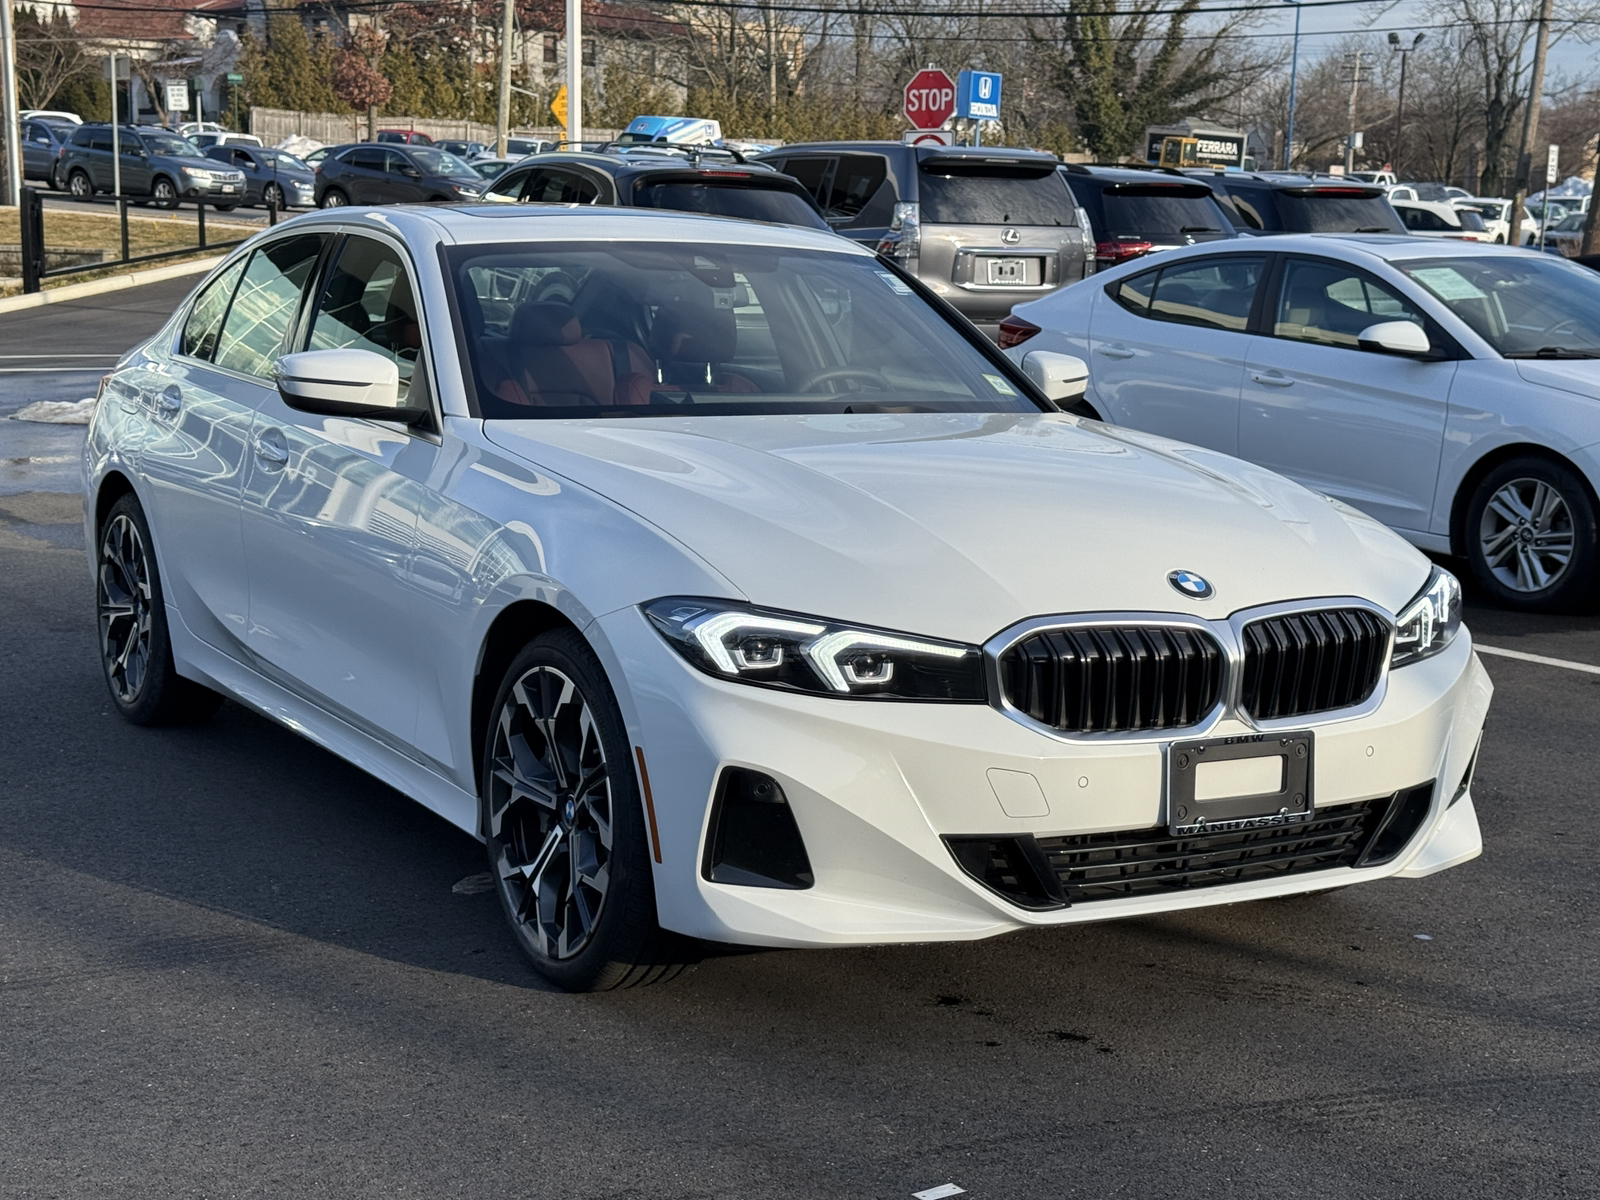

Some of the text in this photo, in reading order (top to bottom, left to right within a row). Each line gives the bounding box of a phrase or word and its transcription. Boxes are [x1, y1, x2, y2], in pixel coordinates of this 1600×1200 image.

[907, 88, 953, 112] STOP
[970, 102, 998, 117] HONDA
[1196, 139, 1238, 155] FERRARA
[1224, 734, 1265, 745] BMW
[1177, 814, 1308, 835] MANHASSET
